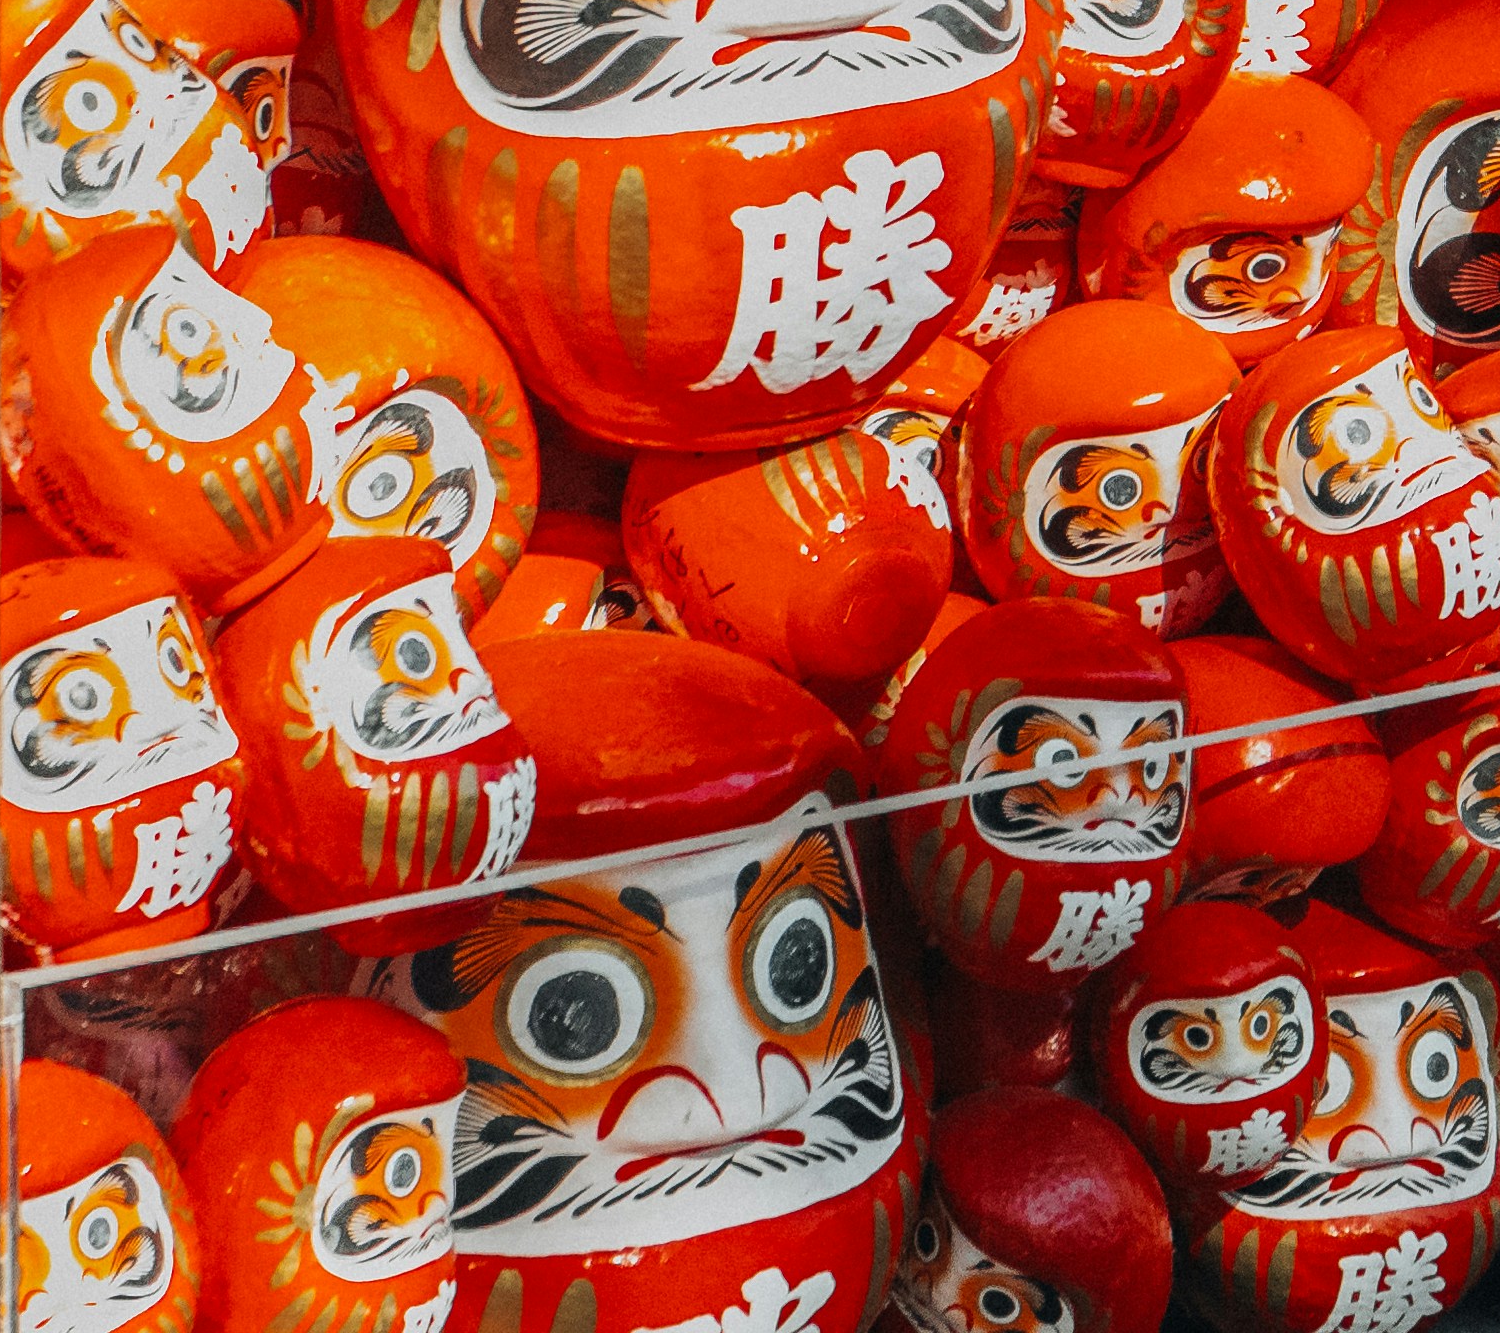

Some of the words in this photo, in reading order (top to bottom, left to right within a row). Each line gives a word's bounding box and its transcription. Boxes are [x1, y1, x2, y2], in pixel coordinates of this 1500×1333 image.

[689, 150, 954, 393] 勝
[115, 781, 232, 918] 勝
[465, 756, 536, 885] 勝
[1028, 878, 1151, 973] 勝
[1207, 1108, 1291, 1177] 勝
[1314, 1231, 1446, 1333] 勝
